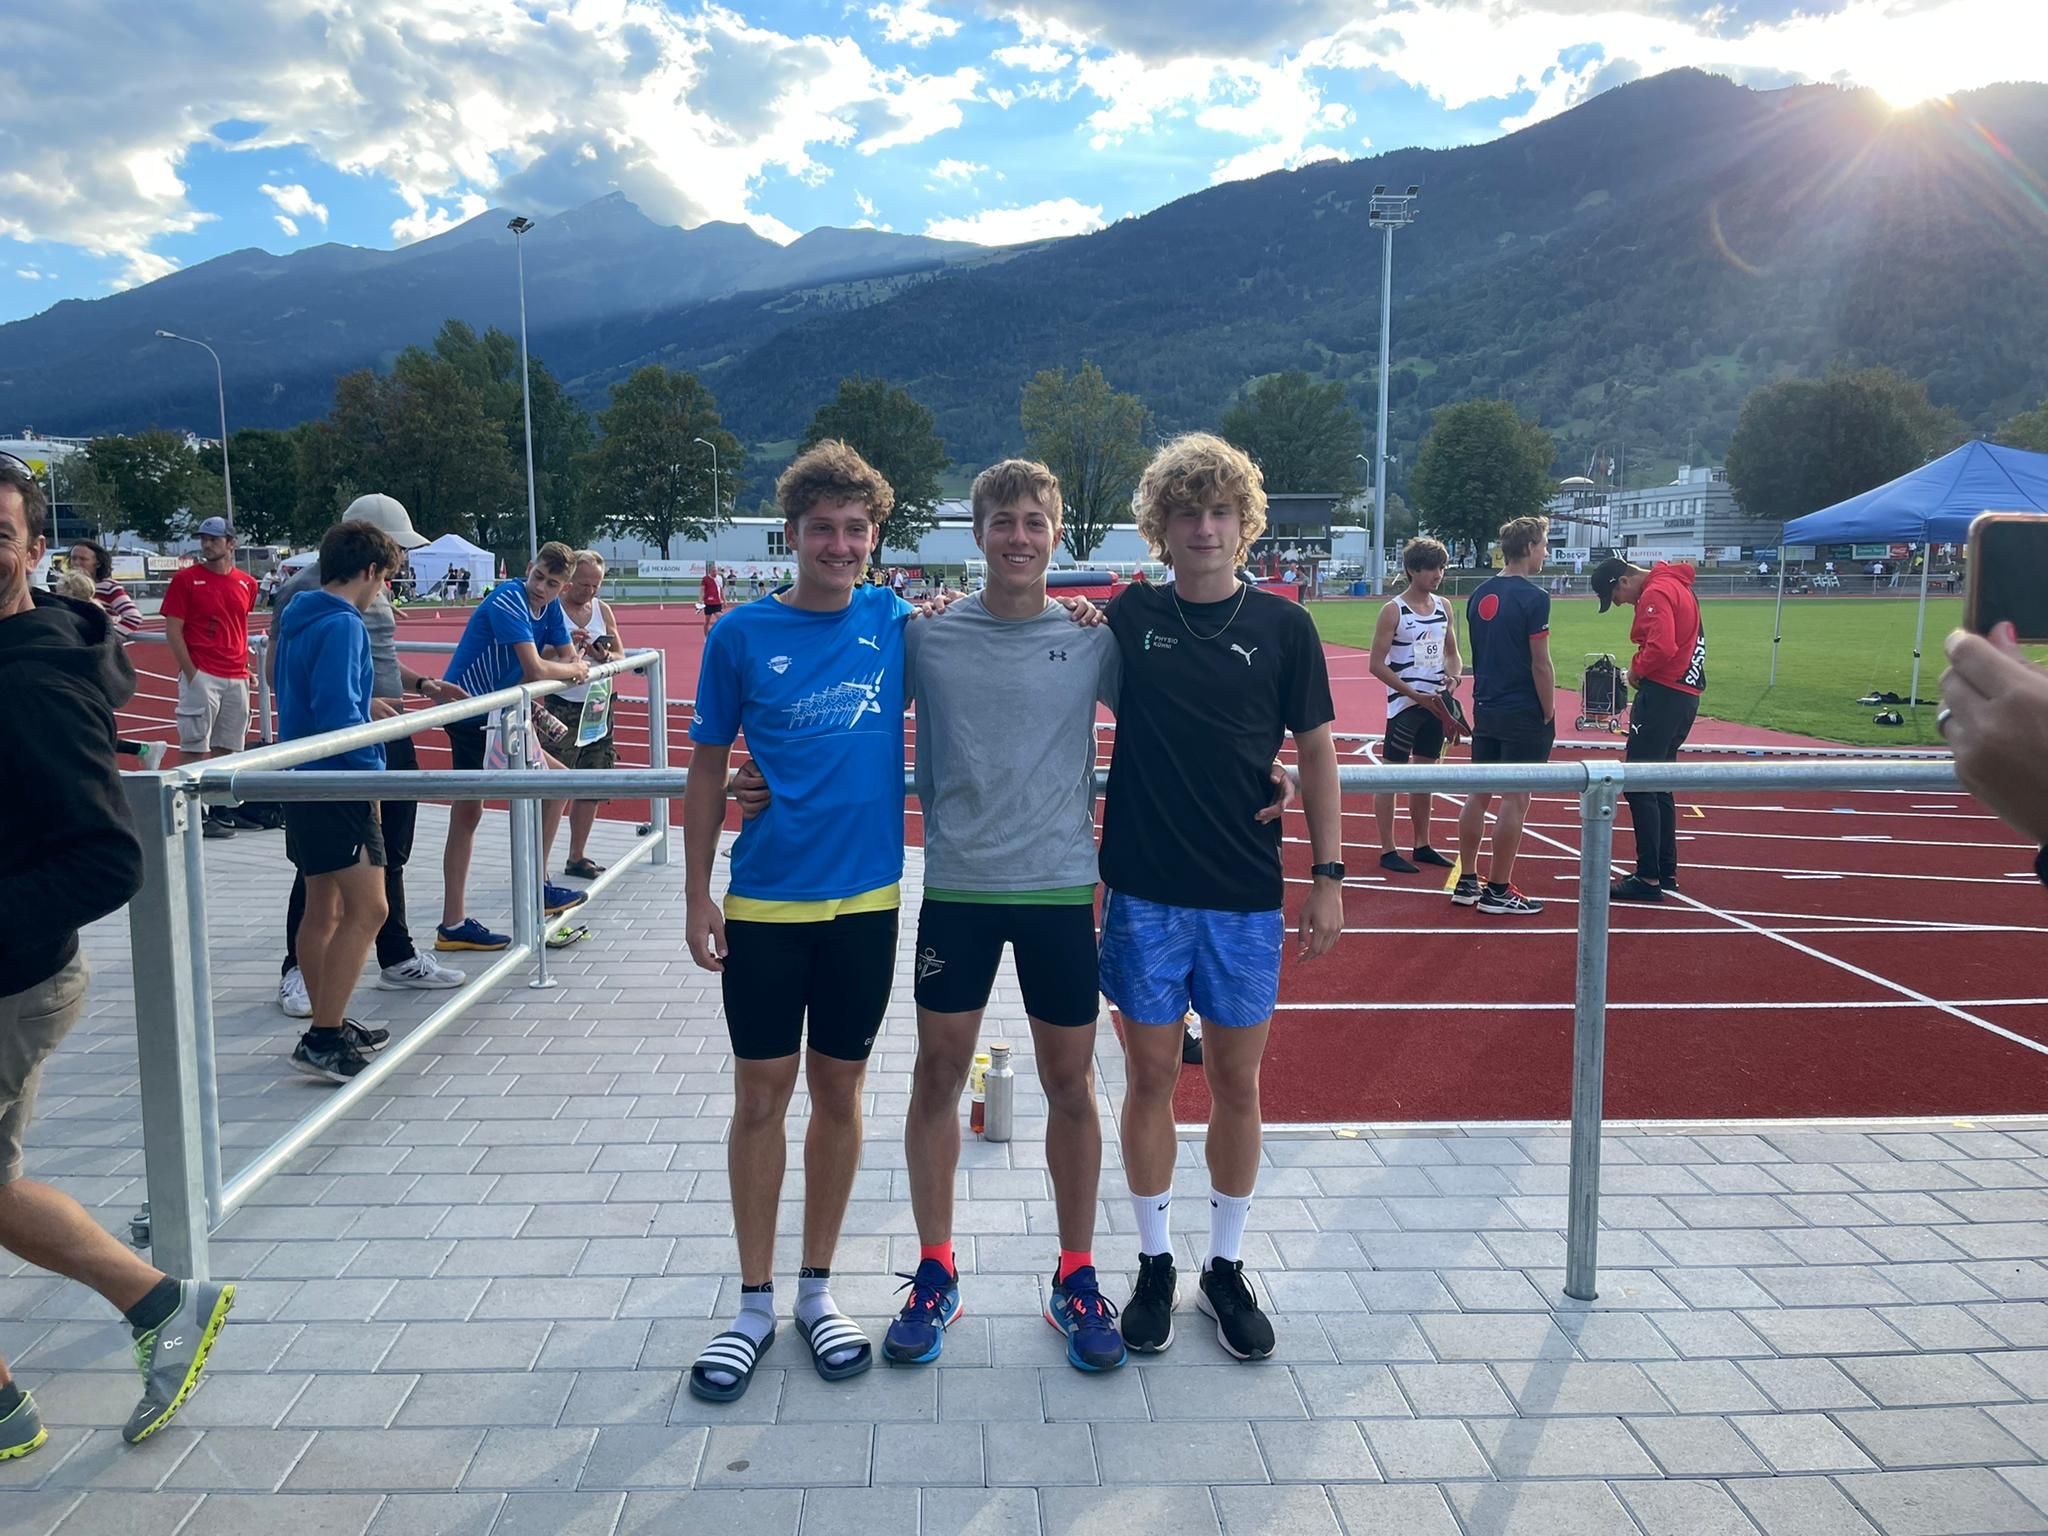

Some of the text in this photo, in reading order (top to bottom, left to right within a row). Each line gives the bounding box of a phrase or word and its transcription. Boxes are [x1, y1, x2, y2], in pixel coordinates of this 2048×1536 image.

[651, 565, 681, 573] HEXAGON
[1154, 635, 1179, 645] PHYSIO
[1426, 644, 1438, 655] 69
